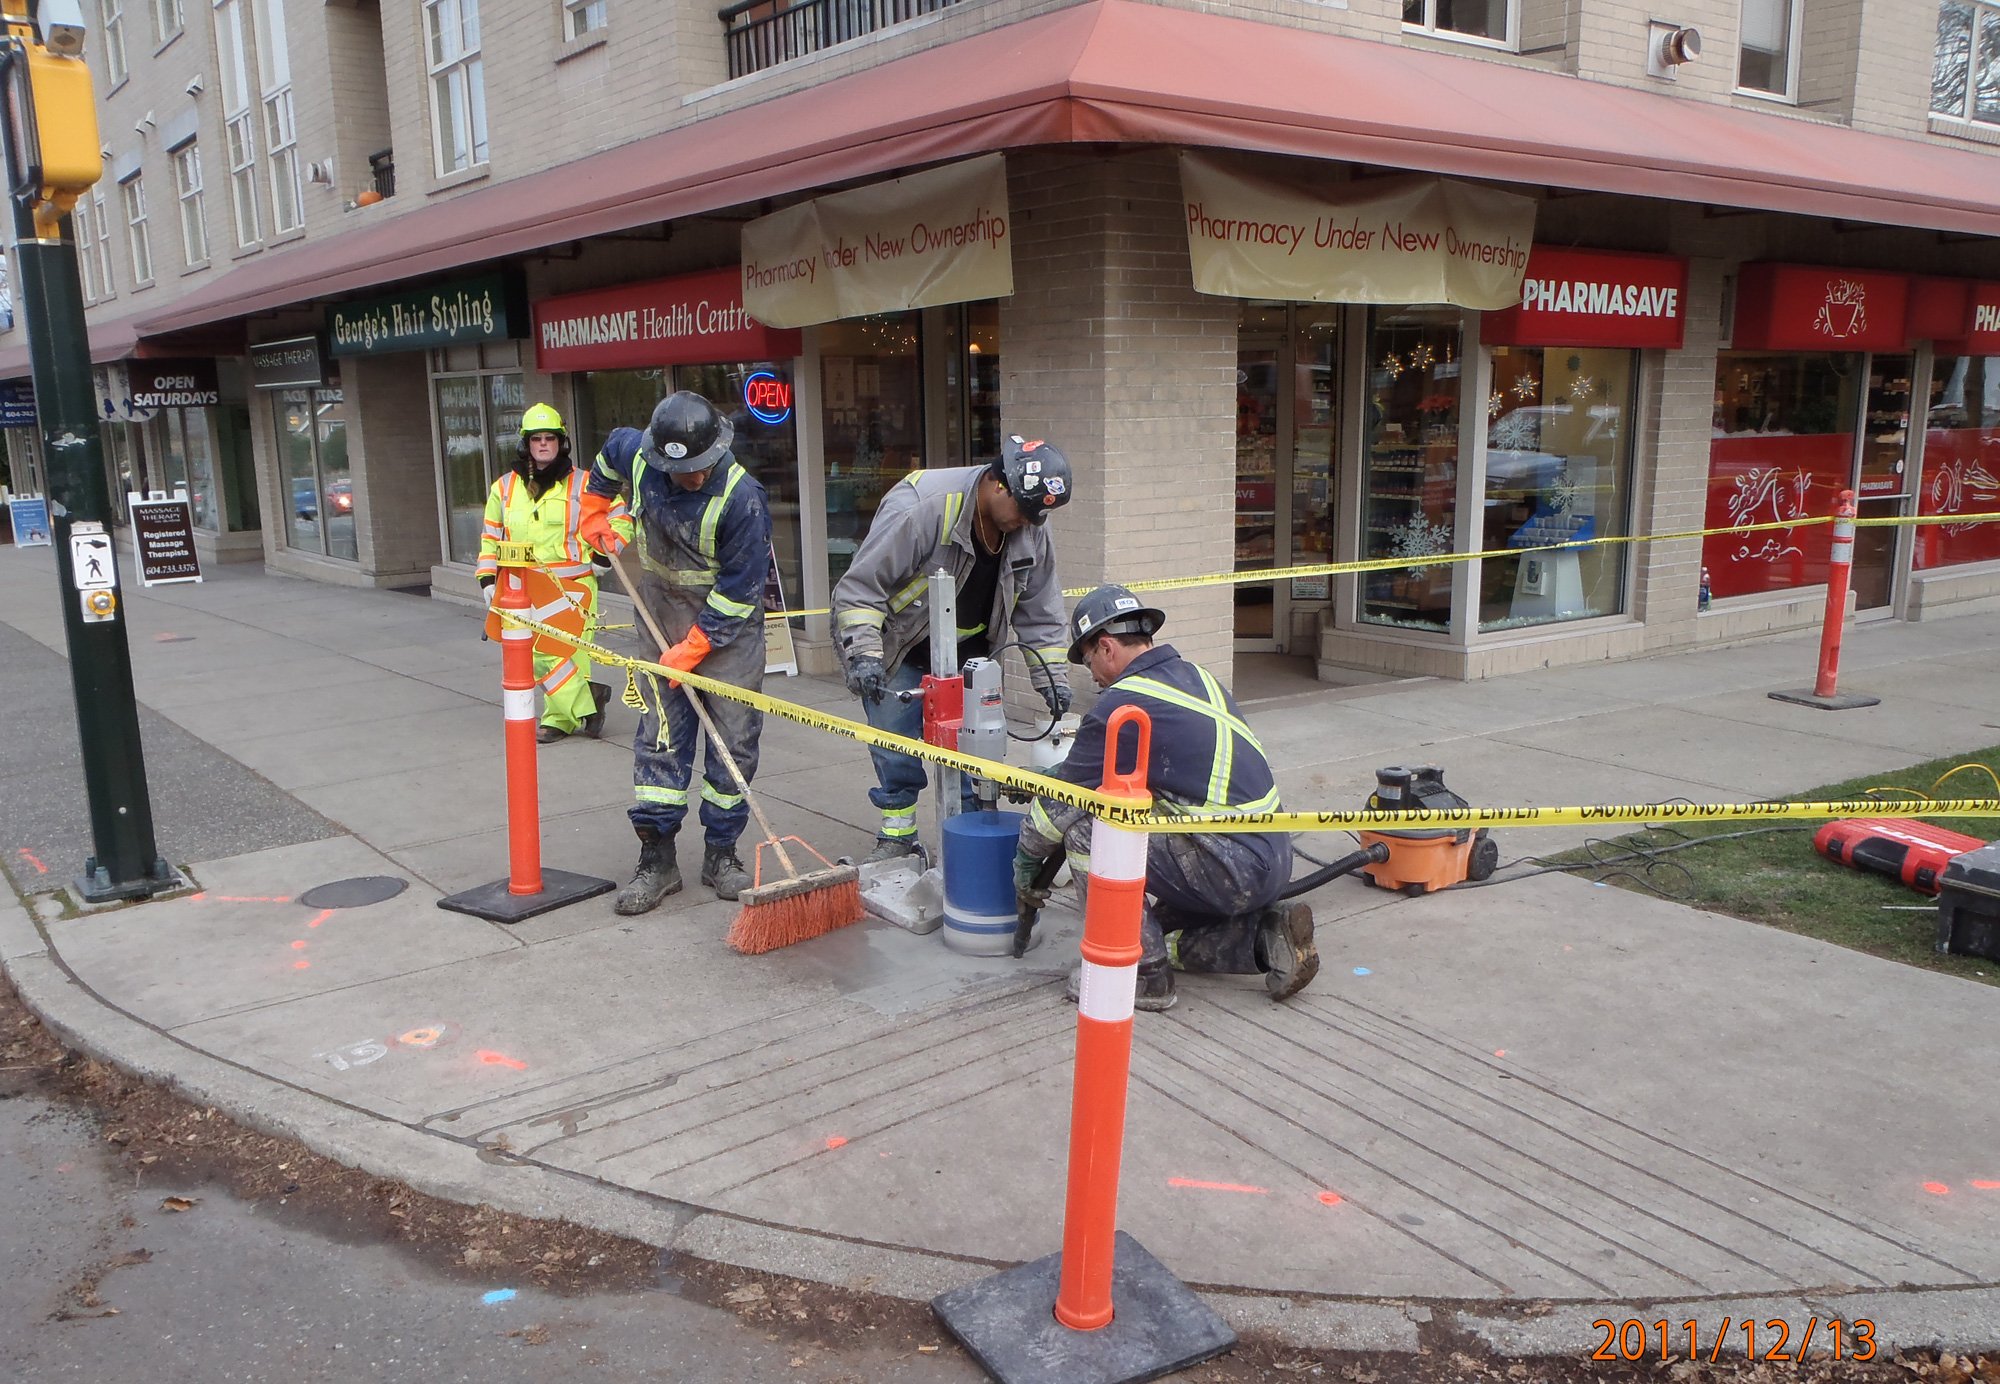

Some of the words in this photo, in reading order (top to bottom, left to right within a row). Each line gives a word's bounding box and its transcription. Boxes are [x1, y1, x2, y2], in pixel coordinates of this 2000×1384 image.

[746, 257, 816, 290] Pharmacy
[865, 232, 905, 263] New
[911, 207, 1005, 254] Ownership
[1188, 203, 1306, 255] Pharmacy
[1314, 217, 1376, 251] Under
[1382, 222, 1440, 251] New
[1446, 226, 1526, 277] Ownership
[1522, 278, 1678, 318] PHARMASAVE
[335, 307, 389, 349] George's
[392, 303, 425, 337] Hair
[431, 290, 494, 337] Styling
[541, 310, 638, 349] PHARMASAVE
[642, 302, 694, 340] Health
[696, 300, 753, 335] Centre
[253, 352, 283, 367] MASSAGE
[284, 349, 315, 364] THERAPY
[154, 376, 195, 389] OPEN
[133, 391, 218, 407] SATURDAYS
[748, 381, 790, 408] OPEN
[143, 529, 186, 539] Registered
[149, 540, 184, 548] Massage
[147, 550, 189, 558] Therapists
[146, 563, 196, 575] 604.733.3376
